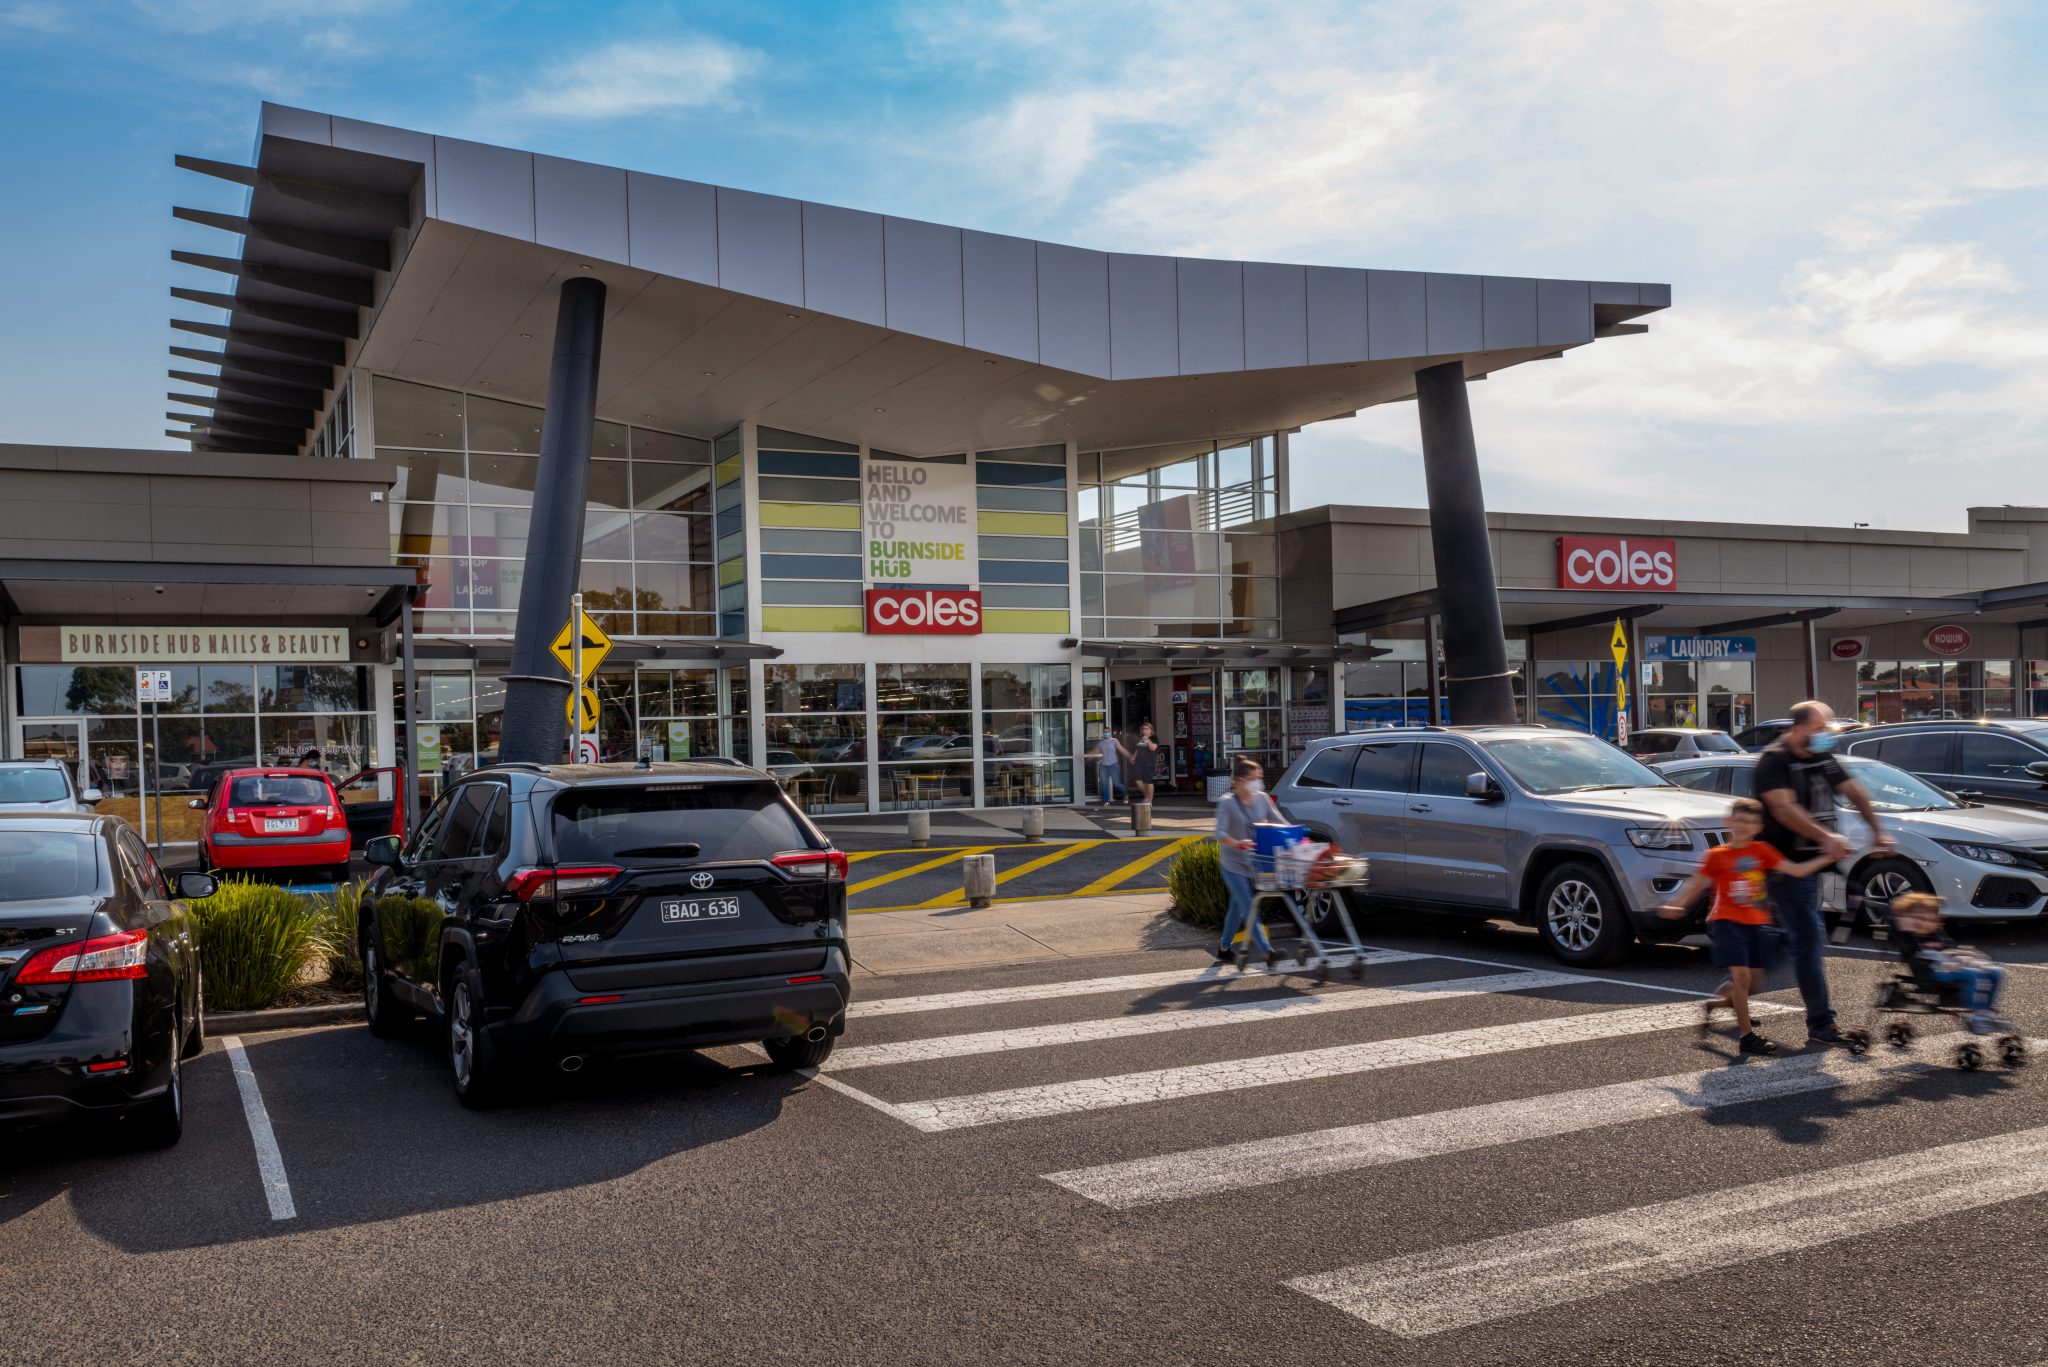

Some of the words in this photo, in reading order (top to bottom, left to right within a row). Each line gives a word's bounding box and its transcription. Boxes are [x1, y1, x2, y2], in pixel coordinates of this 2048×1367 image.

[867, 465, 927, 485] HELLO
[867, 484, 912, 503] AND
[867, 502, 967, 523] WELCOME
[867, 521, 895, 539] TO
[1567, 540, 1673, 585] coles
[873, 591, 979, 626] coles
[69, 633, 159, 654] BURNSIDE
[167, 634, 200, 654] HUB
[278, 634, 341, 654] BEAUTY
[1671, 639, 1730, 657] LAUNDRY
[141, 672, 149, 681] P
[160, 672, 166, 681] P
[580, 748, 589, 764] 5
[669, 903, 700, 919] BAQ
[708, 901, 737, 916] 636
[55, 927, 77, 936] ST
